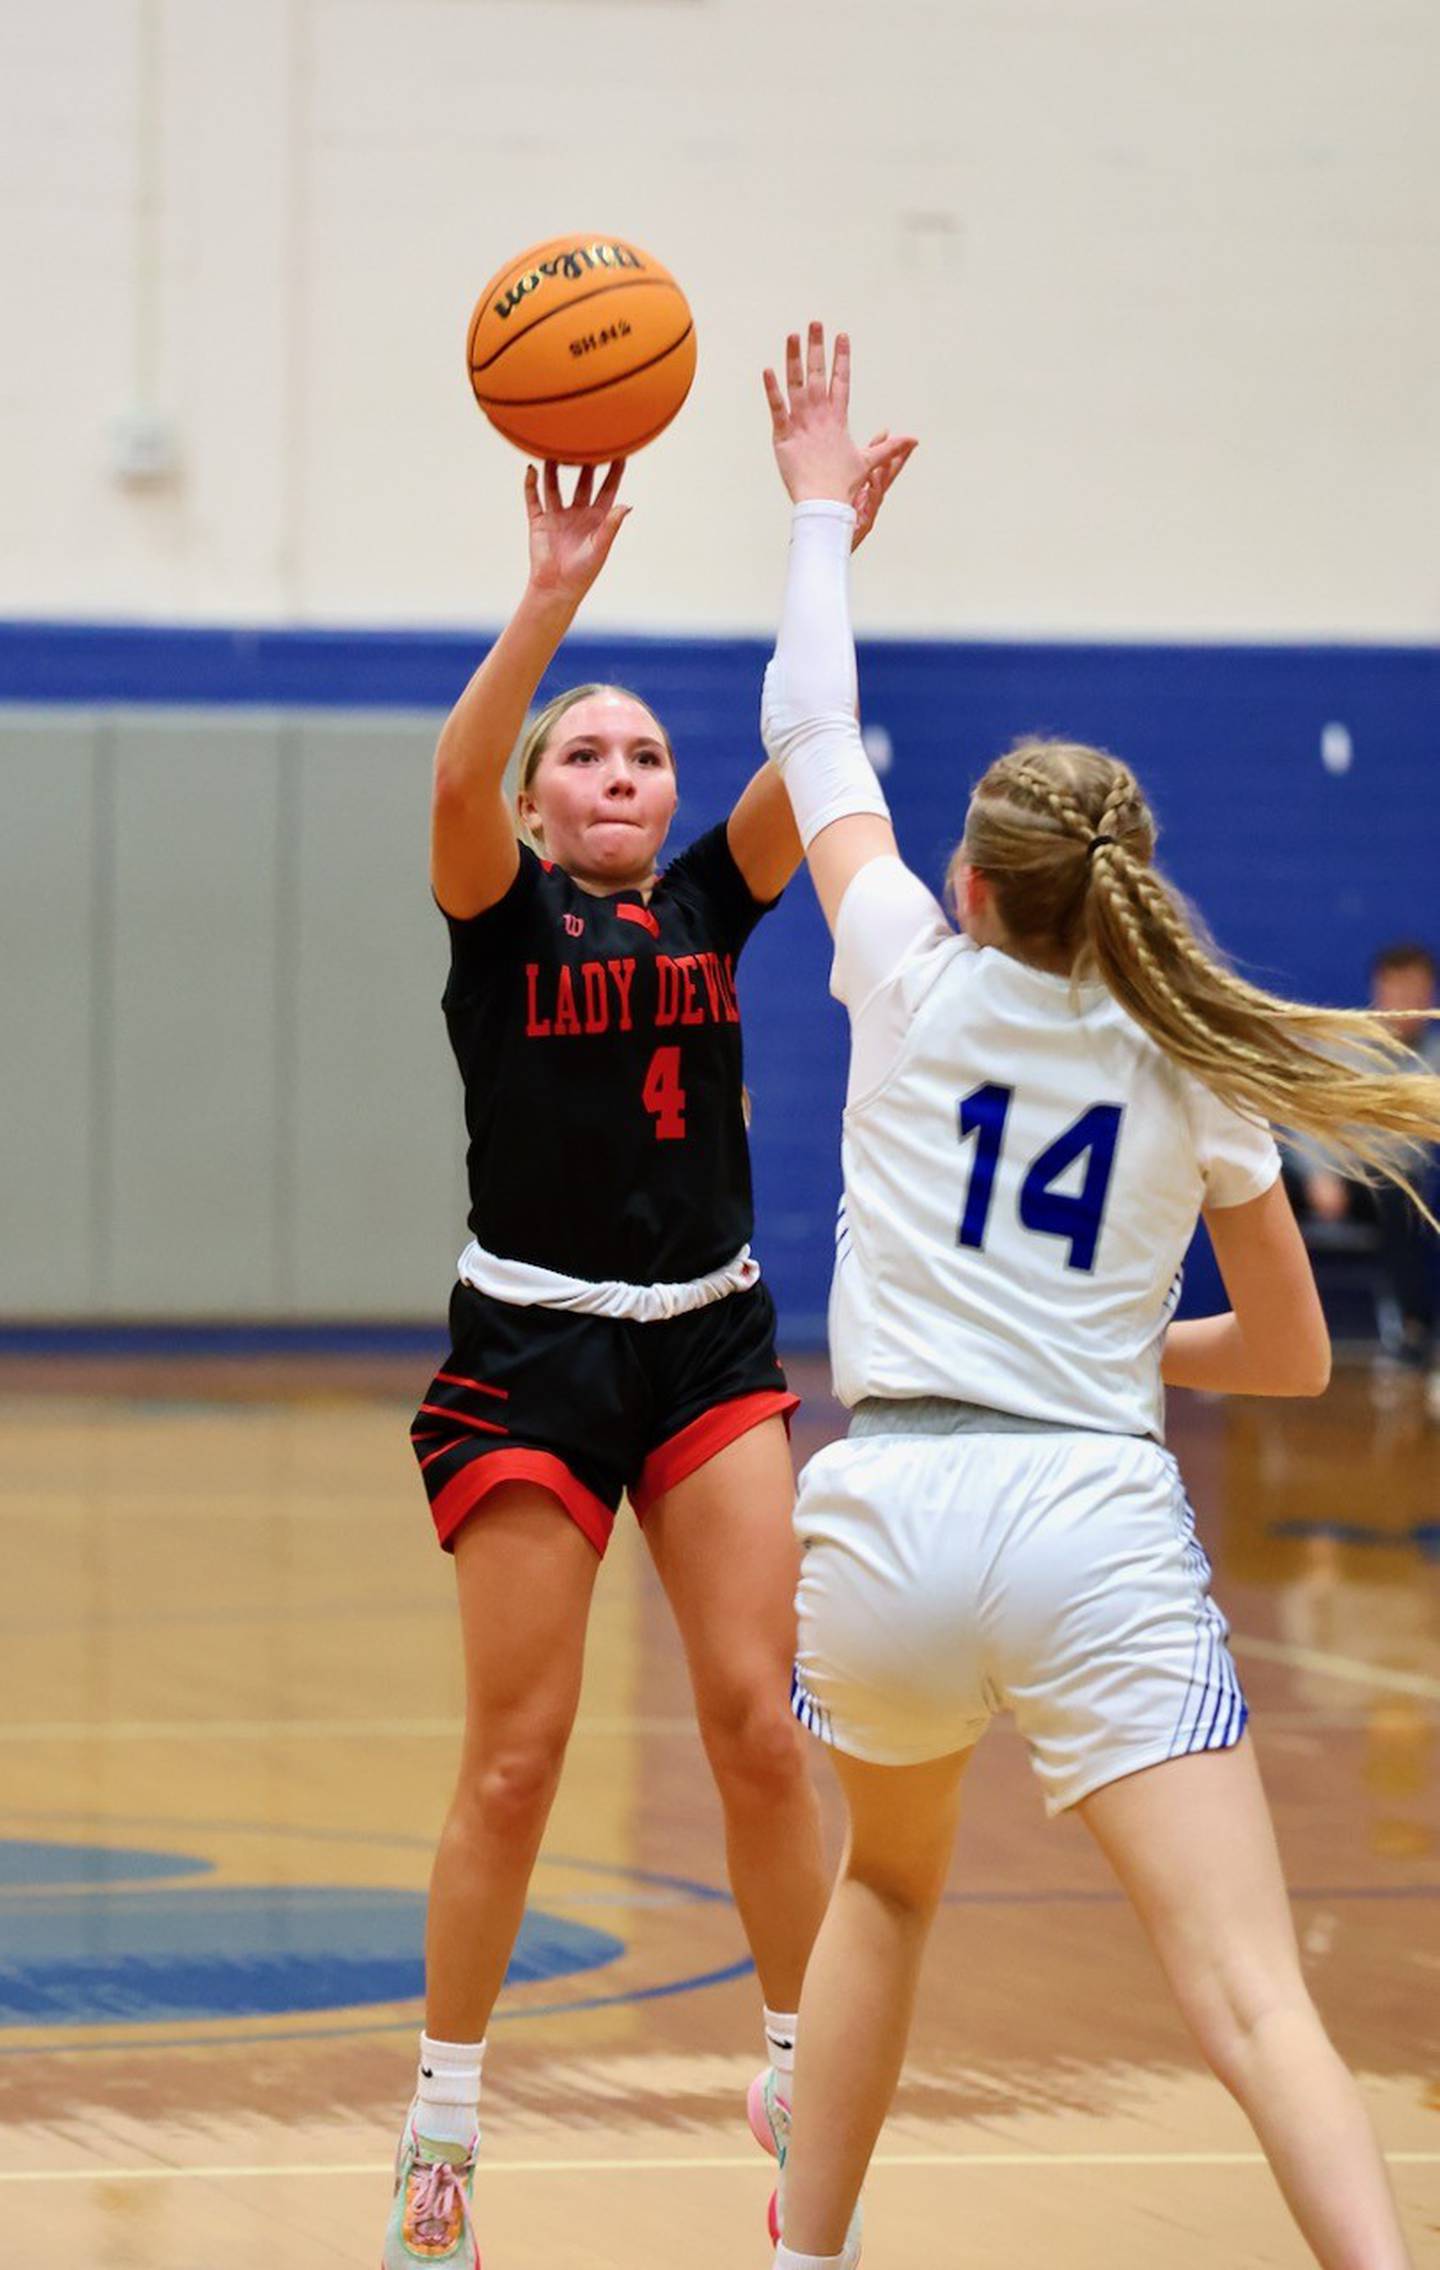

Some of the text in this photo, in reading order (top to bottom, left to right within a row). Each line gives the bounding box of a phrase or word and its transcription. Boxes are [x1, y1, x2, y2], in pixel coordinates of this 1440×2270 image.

[493, 242, 646, 319] Wilson
[525, 958, 637, 1037] LADY
[642, 1046, 687, 1140] 4
[955, 1080, 1127, 1276] 14
